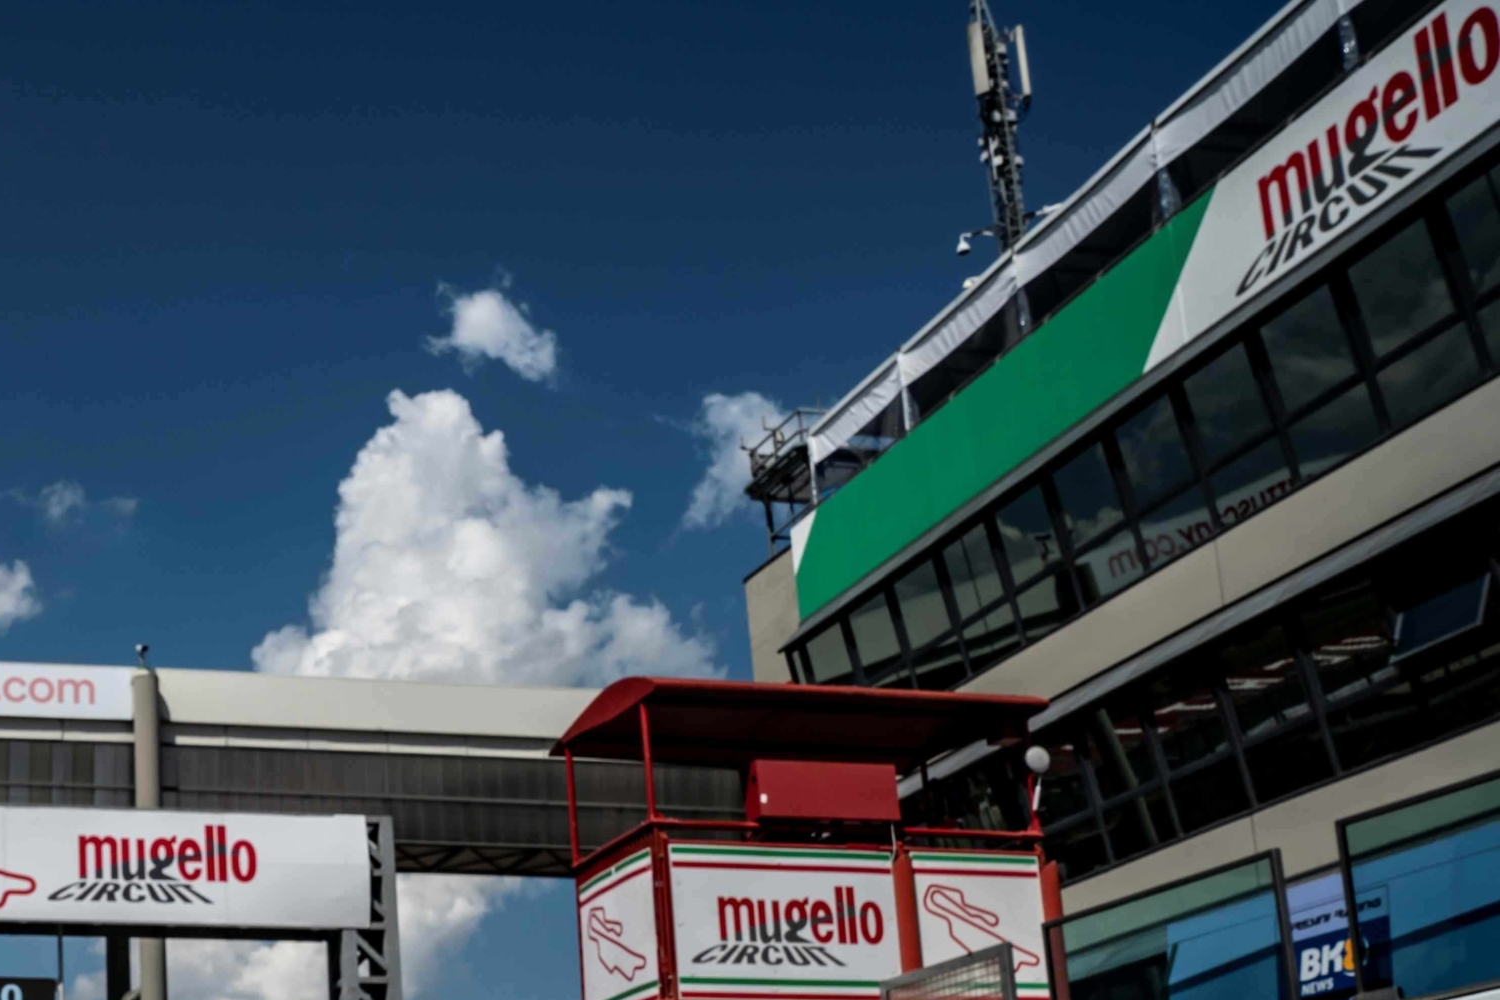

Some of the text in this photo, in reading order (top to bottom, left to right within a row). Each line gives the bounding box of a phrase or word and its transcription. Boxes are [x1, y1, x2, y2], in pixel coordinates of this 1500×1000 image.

[1256, 6, 1500, 241] mugello
[1235, 144, 1443, 297] CIRCUIT
[77, 823, 259, 883] mugello
[47, 881, 214, 905] CIRCUIT
[717, 885, 884, 945] mugello
[691, 943, 847, 967] CIRCUIT
[1301, 977, 1334, 997] NEWS
